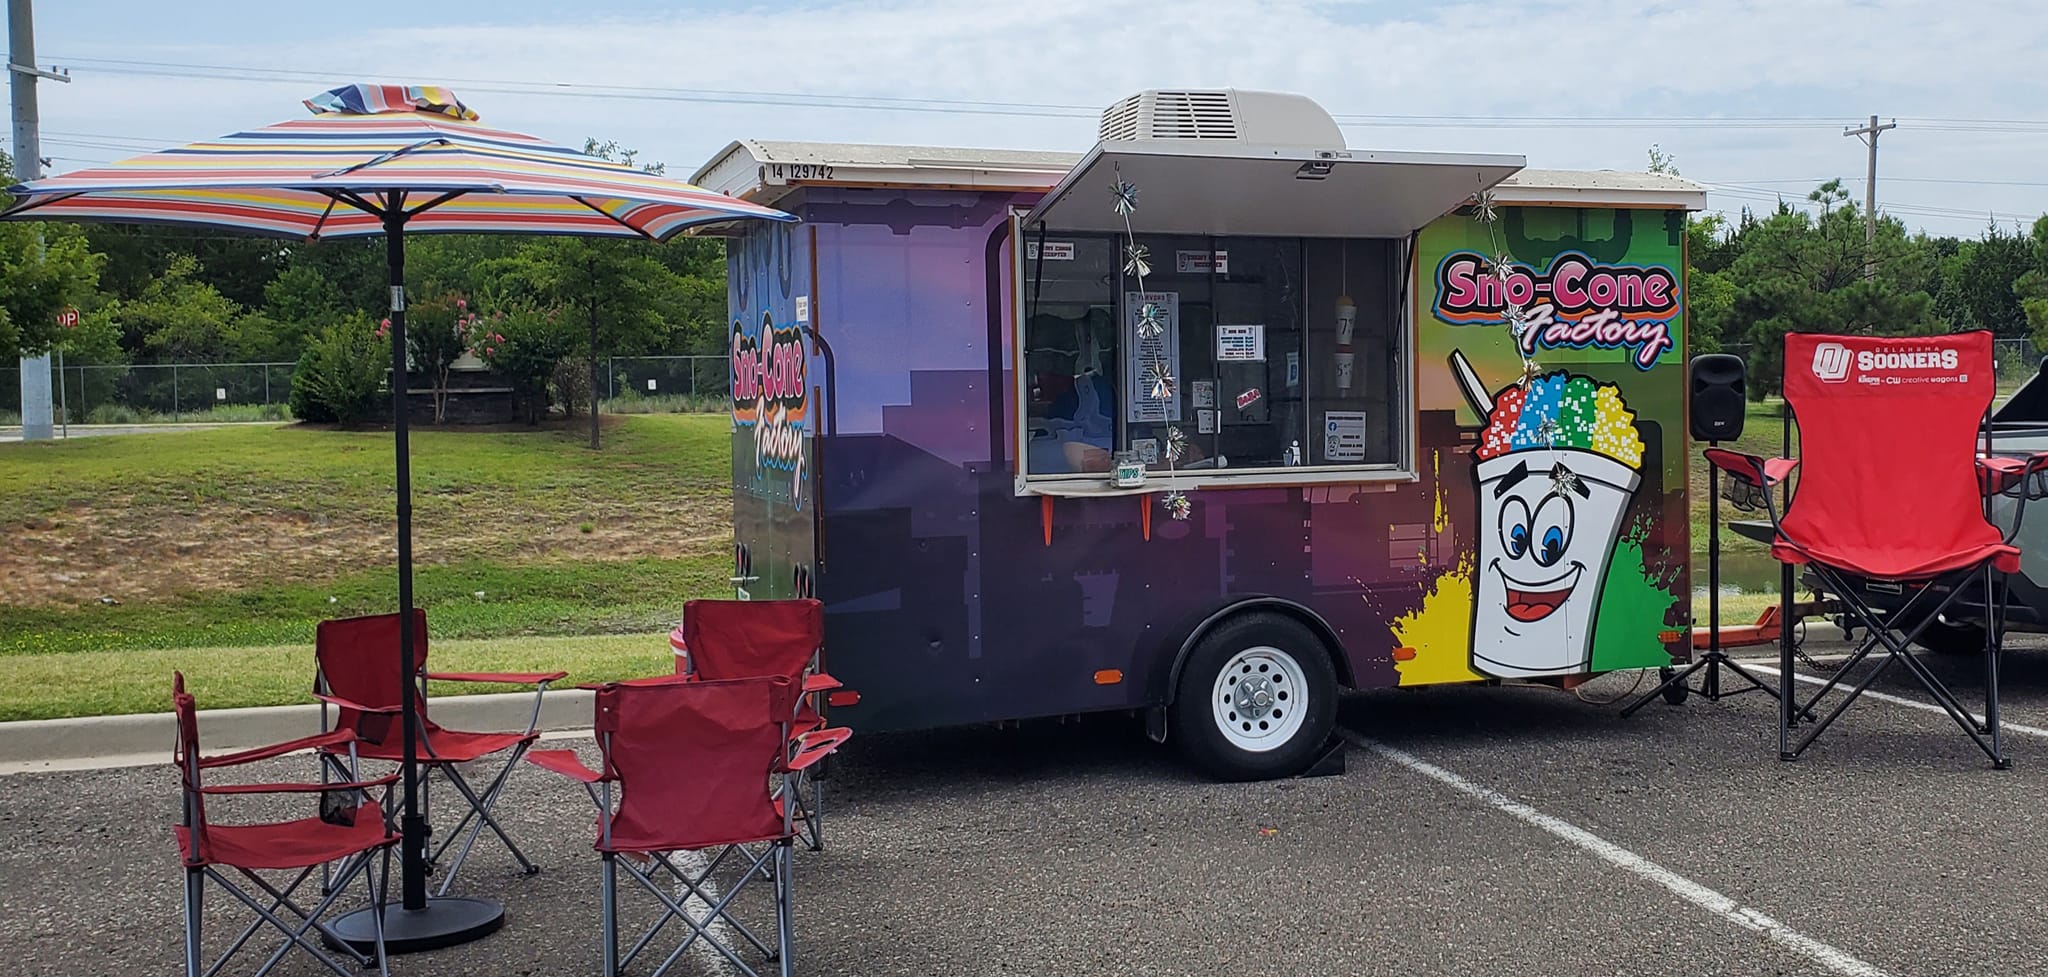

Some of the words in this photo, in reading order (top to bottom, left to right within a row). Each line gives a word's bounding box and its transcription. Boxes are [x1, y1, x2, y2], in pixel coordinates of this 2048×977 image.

[772, 164, 783, 179] 14
[790, 164, 833, 180] 129742
[1447, 260, 1670, 308] Sno-Cone
[57, 312, 76, 327] OP
[1523, 303, 1671, 364] Factory
[733, 323, 804, 401] Sno-Cone
[1857, 349, 1959, 371] SOONERS
[1902, 376, 1930, 384] creative
[1930, 376, 1958, 384] wagons
[754, 395, 805, 499] Factory
